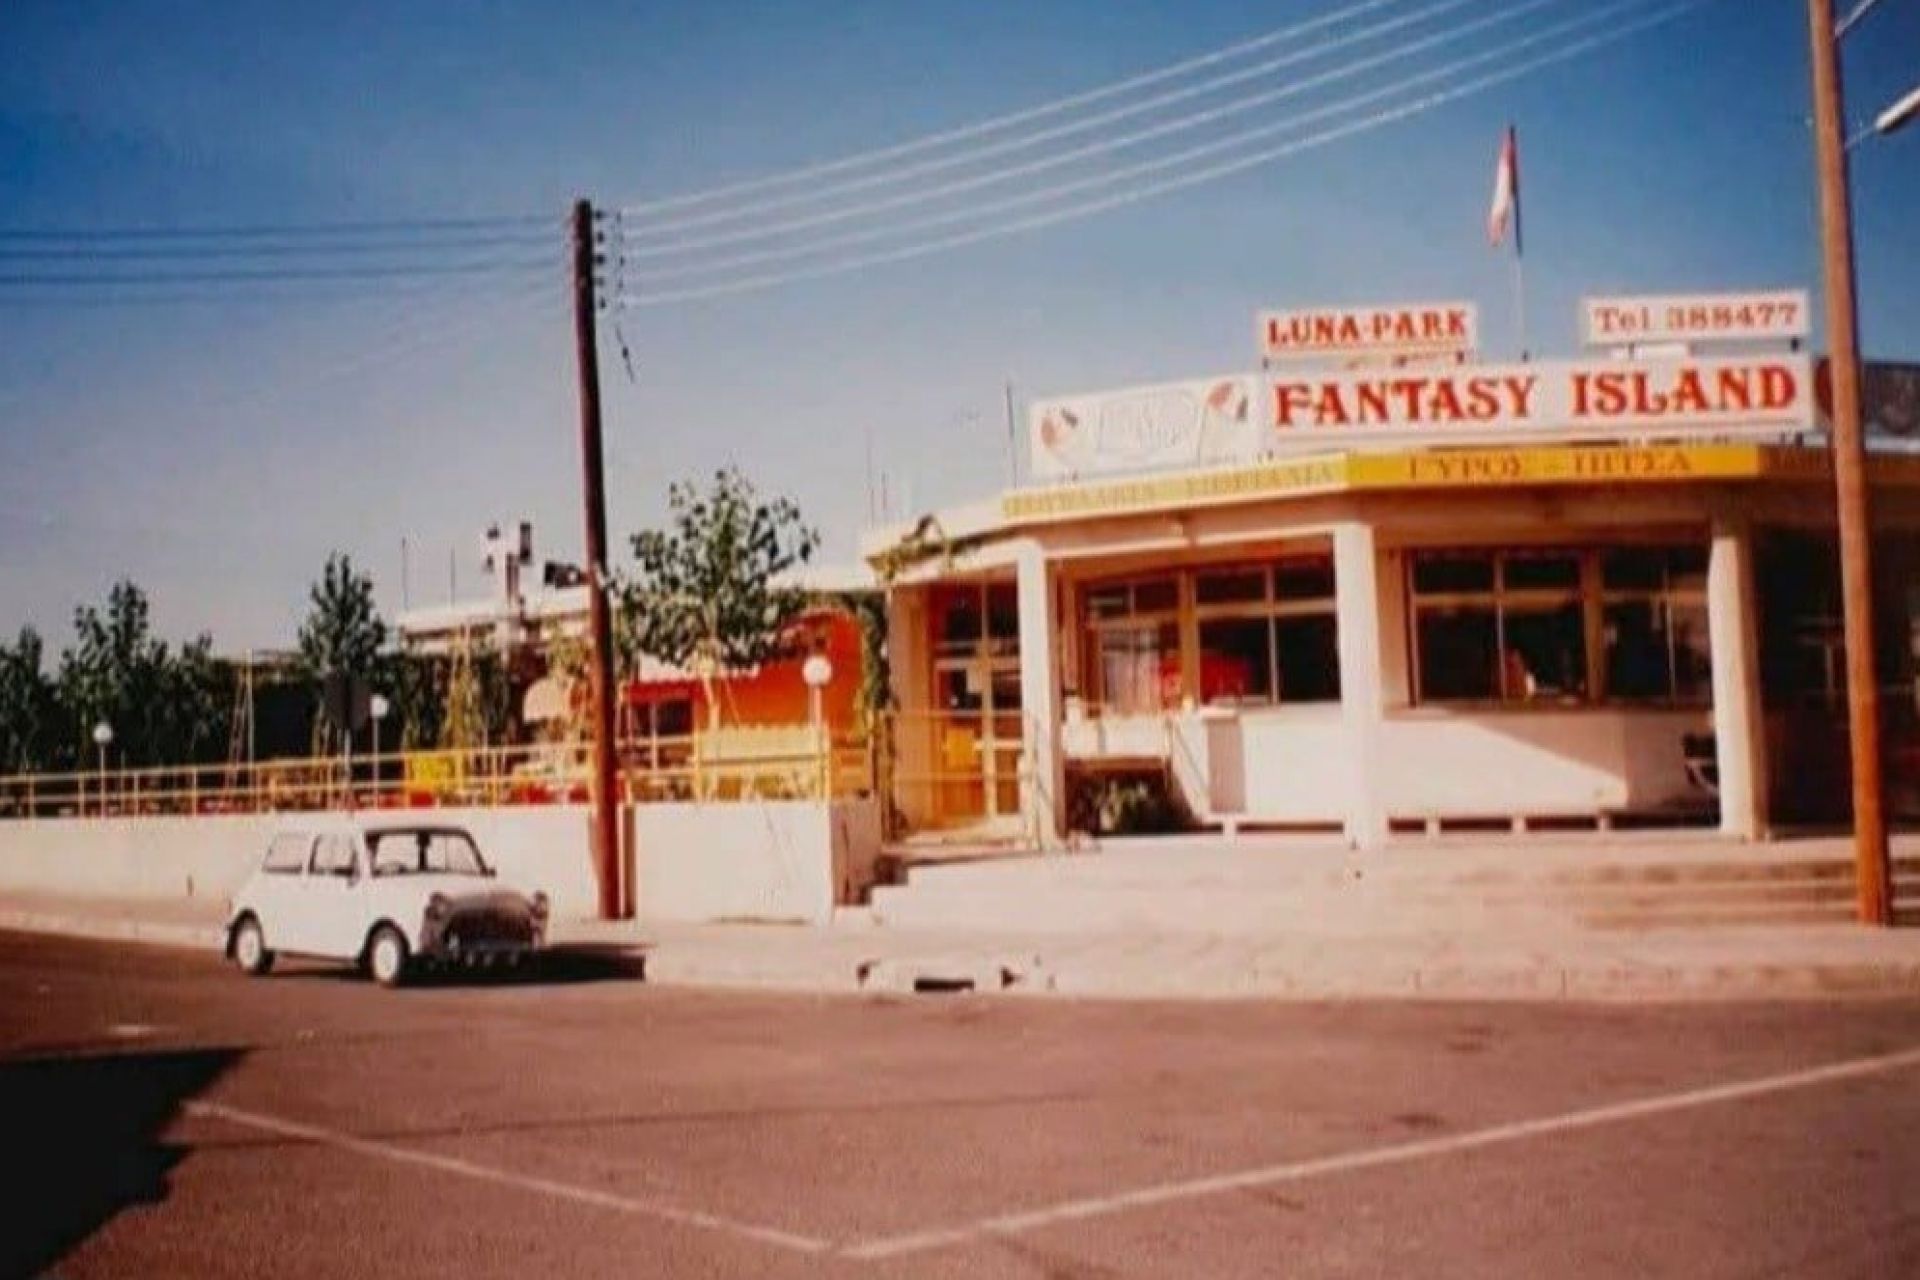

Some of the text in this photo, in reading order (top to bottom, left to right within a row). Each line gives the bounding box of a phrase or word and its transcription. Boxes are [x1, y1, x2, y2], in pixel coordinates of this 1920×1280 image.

[1594, 305, 1649, 331] Tel
[1275, 365, 1797, 427] FANTASY ISLAND
